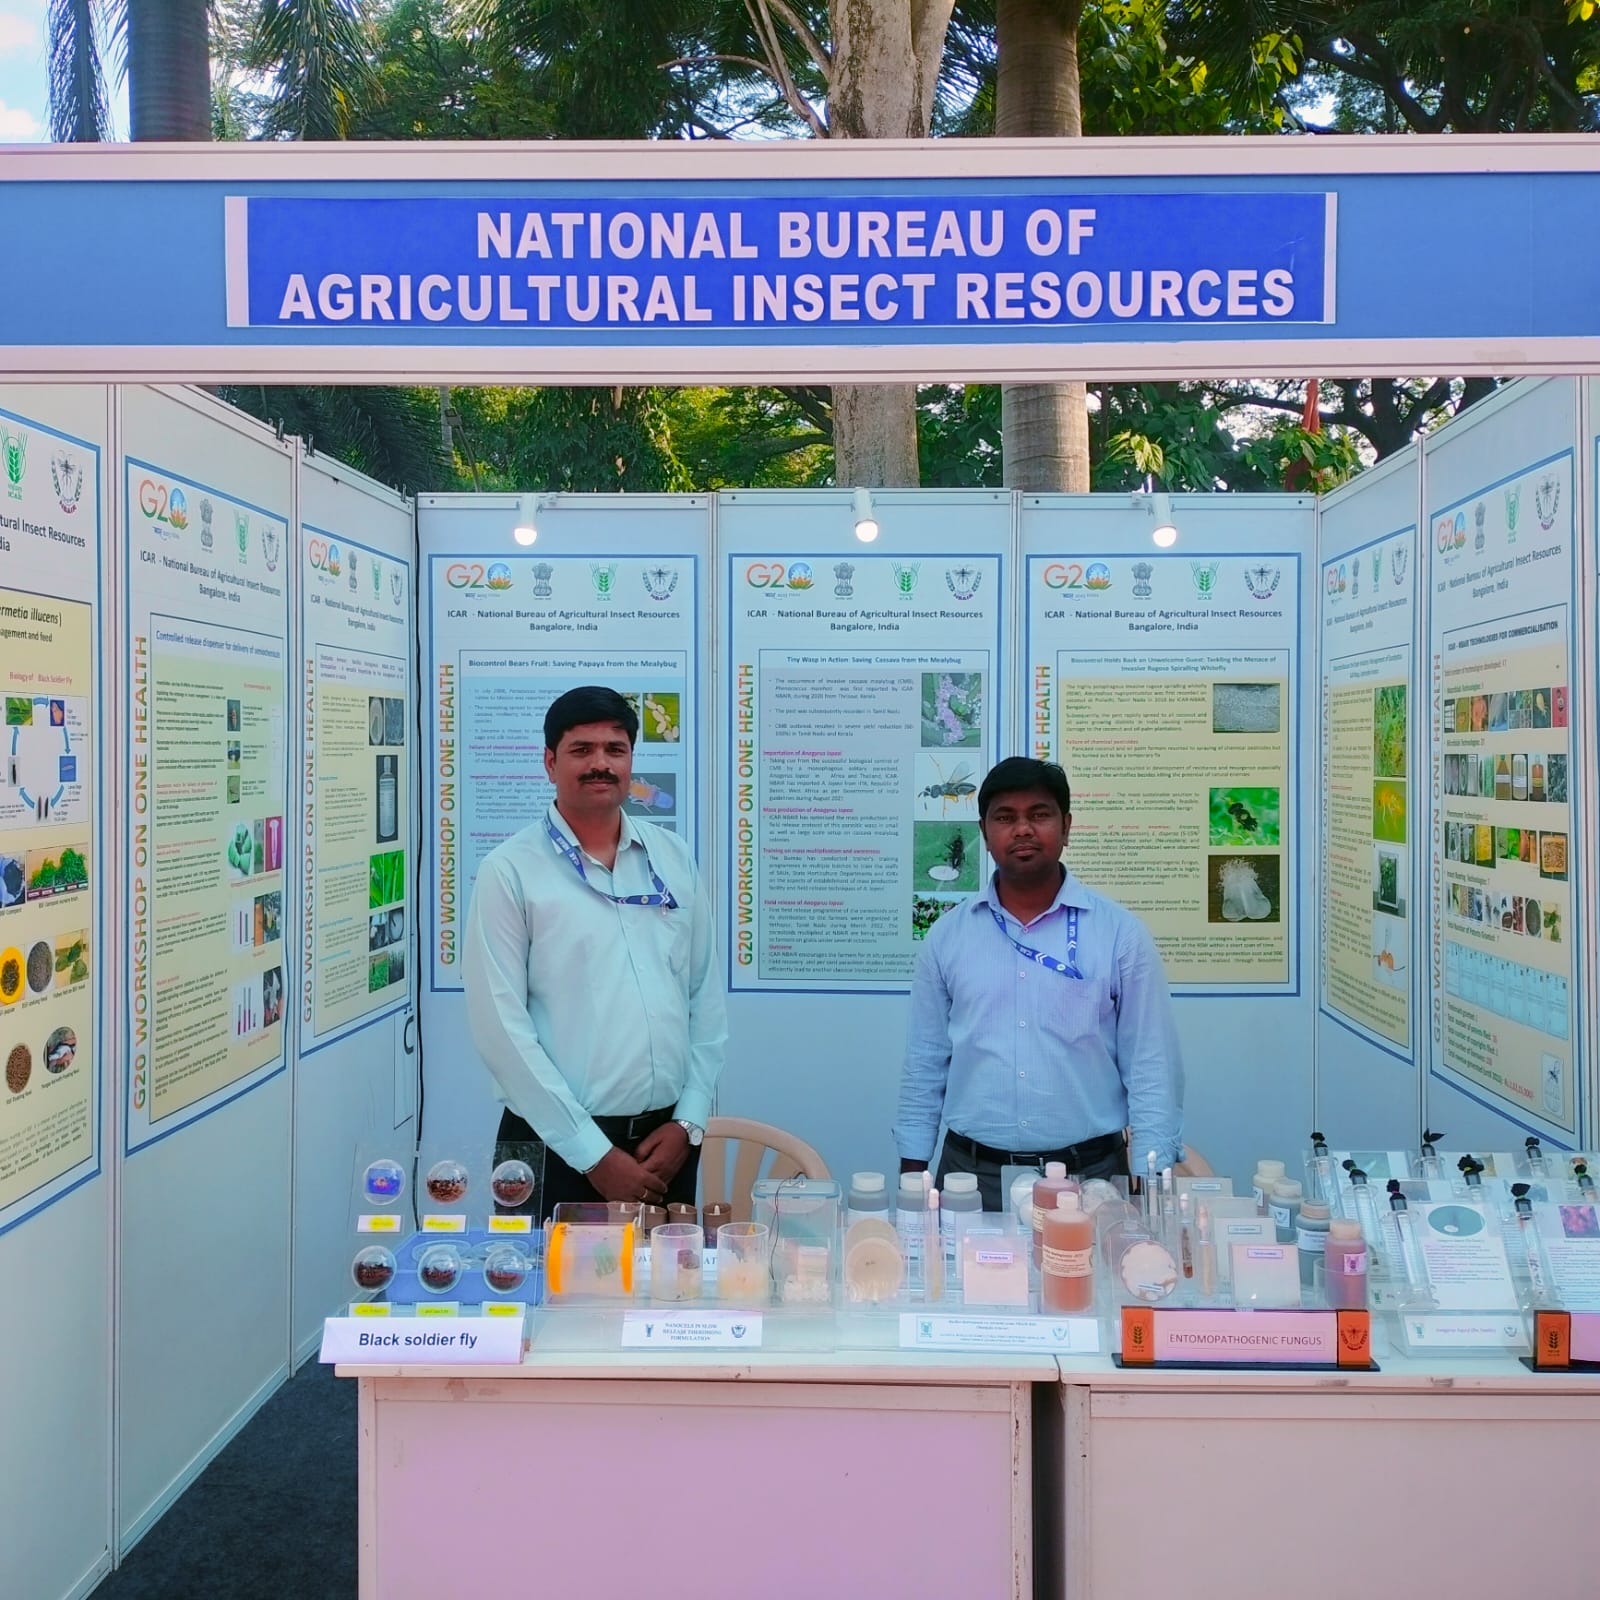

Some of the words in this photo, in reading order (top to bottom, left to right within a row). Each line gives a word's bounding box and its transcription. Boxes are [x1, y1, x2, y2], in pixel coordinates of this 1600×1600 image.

[476, 211, 758, 260] NATIONAL
[778, 209, 1004, 258] BUREAU
[1025, 208, 1096, 256] OF
[279, 273, 712, 322] AGRICULTURAL
[732, 273, 935, 321] INSECT
[956, 268, 1294, 319] RESOURCES
[22, 518, 46, 538] Insect
[48, 526, 86, 548] Resources
[140, 550, 155, 565] ICAR
[163, 557, 188, 571] National
[190, 563, 209, 578] Bureau
[210, 569, 217, 579] of
[217, 570, 245, 587] Agricultural
[246, 579, 259, 590] Insect
[260, 582, 281, 597] Resources
[0, 606, 28, 620] rmetia
[31, 607, 62, 627] illucens)
[446, 609, 468, 619] ICAR
[476, 609, 513, 619] National
[515, 609, 546, 619] Bureau
[547, 609, 557, 619] of
[558, 609, 608, 620] Agricultural
[609, 609, 635, 619] Insect
[636, 609, 680, 619] Resources
[529, 622, 575, 633] Bangalore,
[576, 622, 598, 631] India
[746, 609, 768, 618] ICAR
[777, 609, 814, 618] National
[815, 609, 847, 618] Bureau
[848, 609, 858, 618] of
[859, 609, 910, 620] Agricultural
[911, 609, 938, 618] Insect
[939, 609, 983, 618] Resources
[830, 622, 876, 633] Bangalore,
[877, 622, 900, 631] India
[1044, 609, 1065, 618] ICAR
[1074, 609, 1112, 618] National
[1114, 609, 1145, 618] Bureau
[1147, 609, 1157, 618] of
[1158, 609, 1209, 620] Agricultural
[1210, 609, 1237, 618] Insect
[1238, 609, 1282, 618] Resources
[1128, 622, 1175, 633] Bangalore,
[1176, 622, 1199, 631] India
[28, 632, 39, 640] and
[468, 659, 507, 667] Biocontrol
[508, 659, 529, 667] Bears
[530, 659, 551, 667] Fruit:
[552, 659, 577, 669] Saving
[577, 659, 605, 669] Papaya
[605, 659, 625, 667] from
[625, 659, 639, 667] the
[640, 659, 677, 669] Mealybug
[786, 656, 800, 664] Tiny
[801, 656, 819, 664] Wasp
[851, 656, 872, 665] Saving
[929, 656, 961, 665] Mealybug
[135, 636, 147, 744] HEALTH
[306, 658, 314, 741] HEALTH
[440, 664, 454, 732] HEALTH
[738, 664, 754, 733] HEALTH
[1035, 666, 1050, 734] HEALTH
[1432, 655, 1441, 742] HEALTH
[305, 751, 314, 796] ONE
[440, 739, 455, 778] ONE
[738, 739, 754, 778] ONE
[1432, 751, 1440, 798] ONE
[134, 753, 147, 814] ONE
[440, 784, 455, 812] ON
[738, 784, 754, 812] ON
[305, 803, 314, 837] ON
[1432, 808, 1441, 844] ON
[134, 824, 147, 868] ON
[440, 816, 456, 925] WORKSHOP
[738, 818, 753, 926] WORKSHOP
[304, 844, 314, 972] WORKSHOP
[1432, 850, 1441, 988] WORKSHOP
[134, 878, 147, 1046] WORKSHOP
[440, 930, 456, 965] G20
[738, 930, 753, 966] G20
[304, 980, 312, 1024] G20
[134, 1054, 146, 1110] G20
[358, 1332, 400, 1346] Black
[404, 1332, 456, 1346] soldier
[459, 1332, 478, 1349] fly
[1169, 1333, 1278, 1345] ENTOMOPATHOGENIC
[1281, 1335, 1322, 1346] FUNGUS
